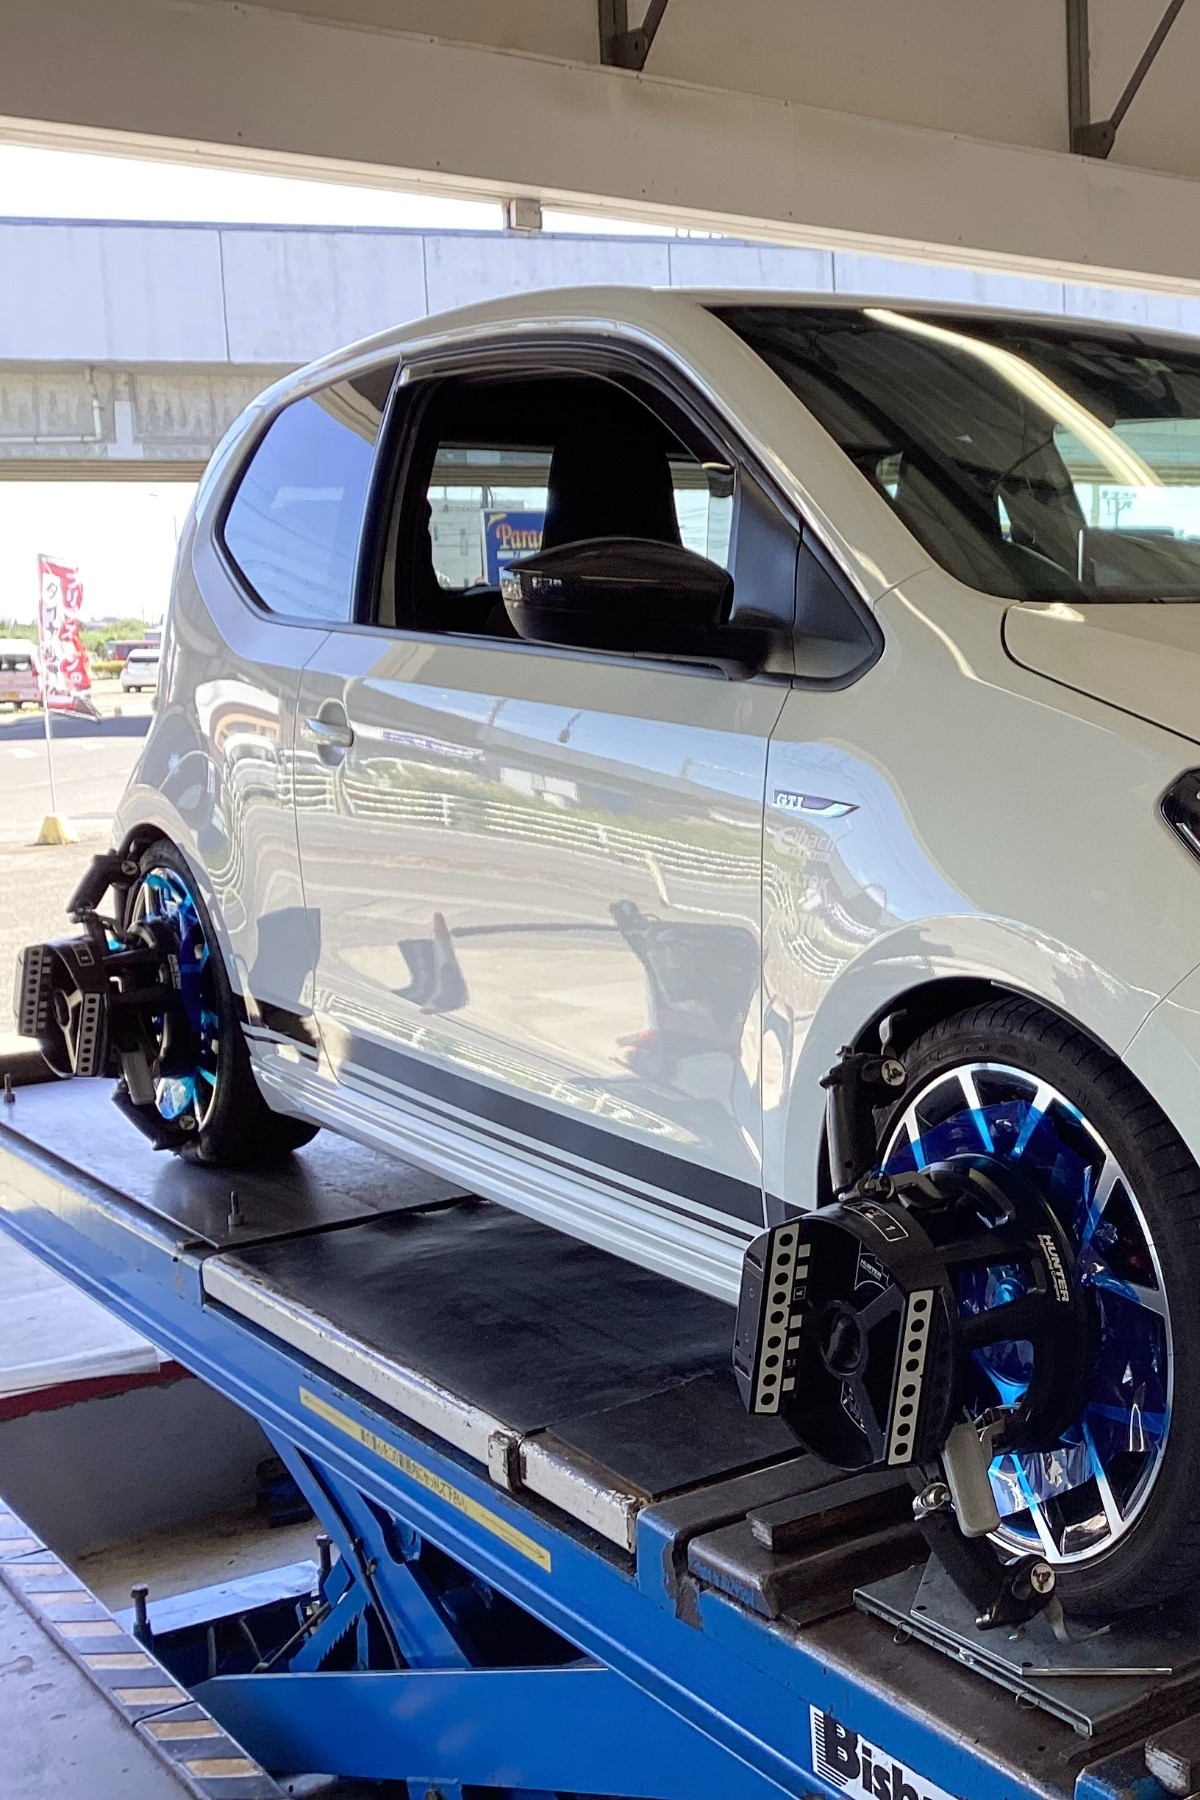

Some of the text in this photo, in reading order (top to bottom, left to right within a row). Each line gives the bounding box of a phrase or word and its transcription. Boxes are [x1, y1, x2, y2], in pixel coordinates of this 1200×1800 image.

[776, 793, 804, 810] GTI
[1042, 1234, 1070, 1302] HUNTER
[823, 1712, 933, 1800] Bish
